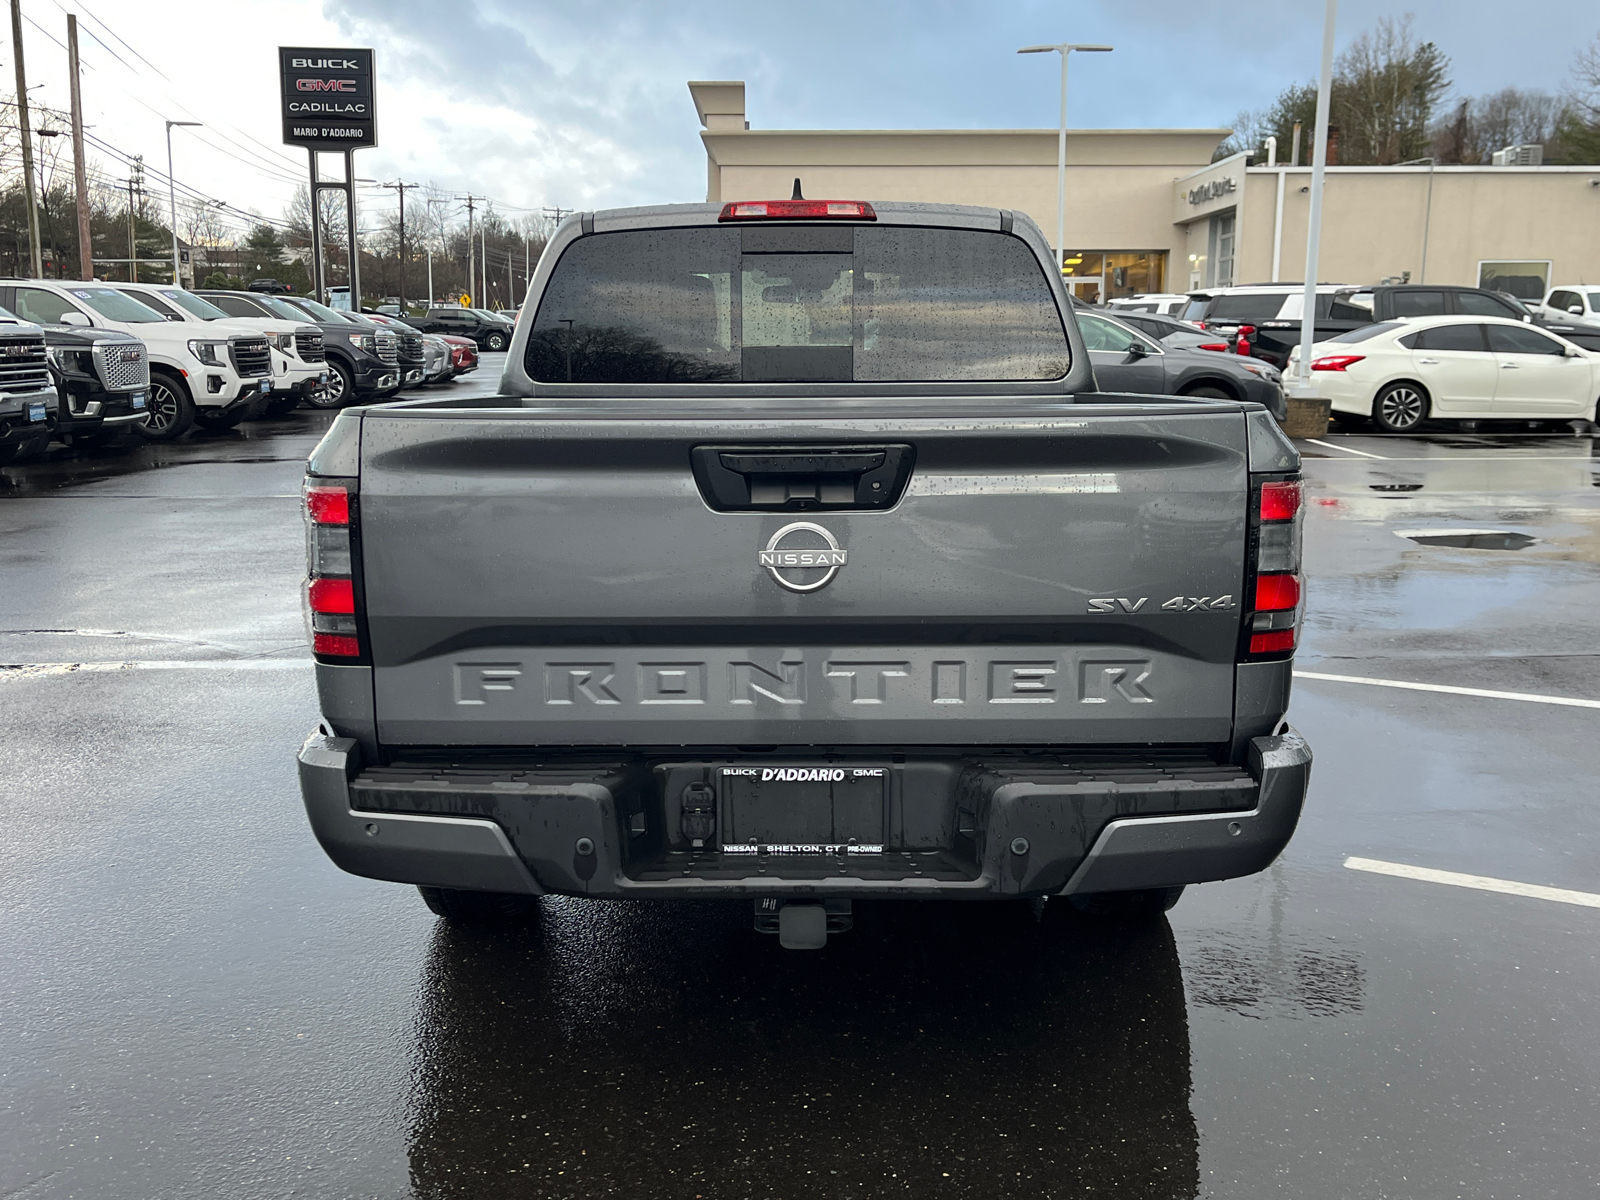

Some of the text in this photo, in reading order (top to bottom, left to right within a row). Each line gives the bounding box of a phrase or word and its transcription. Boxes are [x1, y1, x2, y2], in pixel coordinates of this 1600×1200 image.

[292, 58, 359, 69] BUICK
[296, 78, 357, 93] GMC
[289, 102, 366, 113] CADILLAC
[293, 127, 364, 138] MARIO D'ADDARIO
[761, 553, 845, 565] NISSAN
[1087, 597, 1148, 614] SV
[453, 661, 1155, 706] FRONTIER
[723, 768, 883, 782] BUICK D'ADDARIO GMC
[766, 845, 822, 853] SHELTON,
[847, 845, 882, 853] PRE-OWNED
